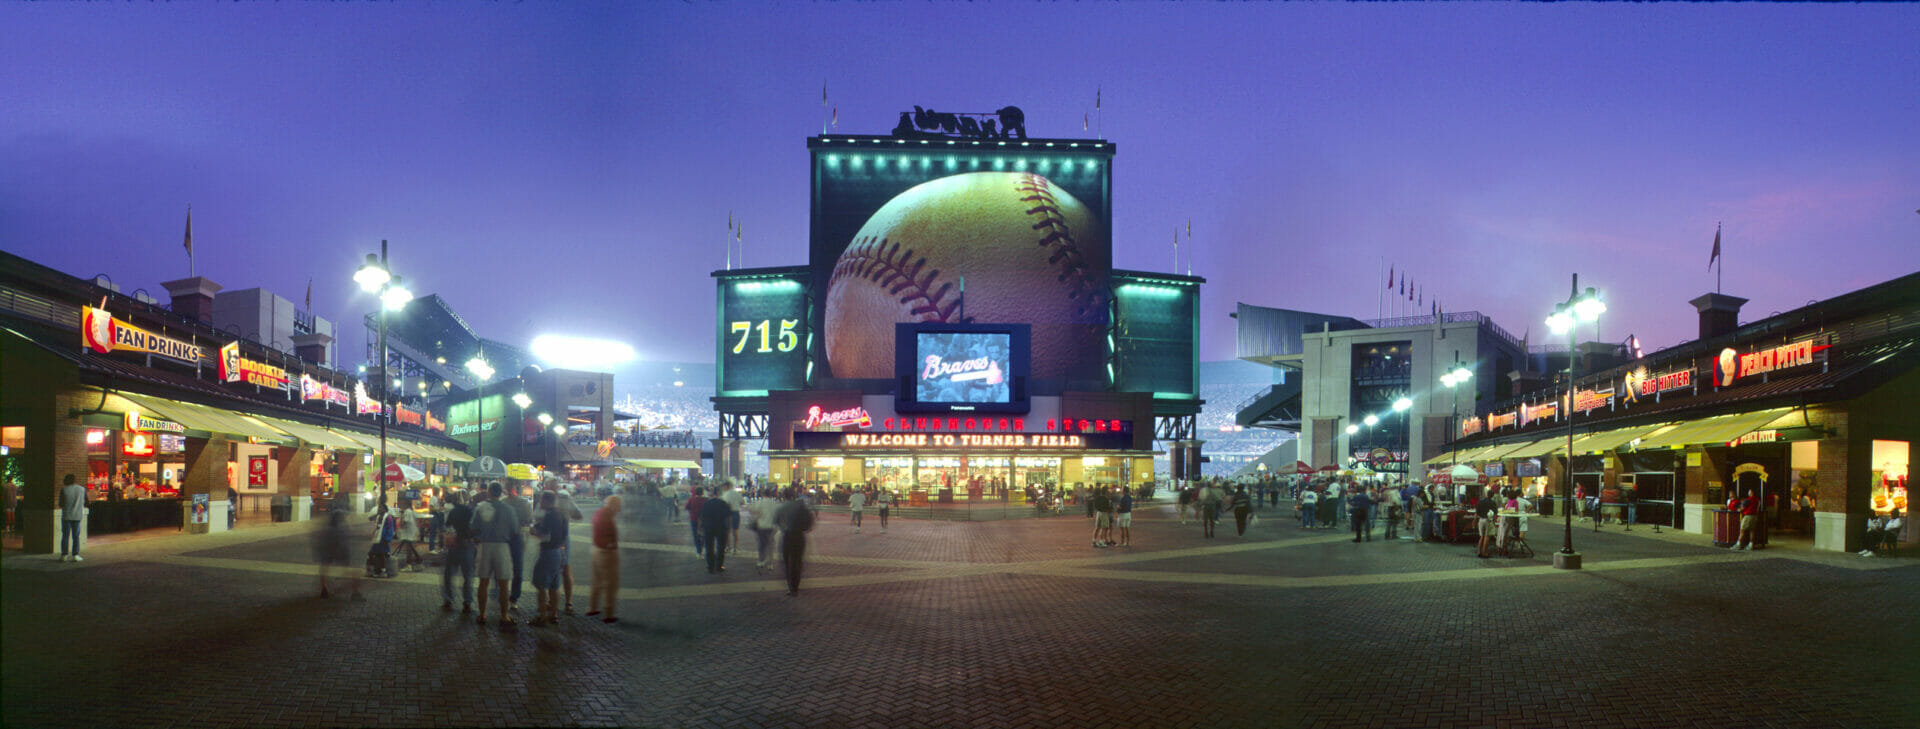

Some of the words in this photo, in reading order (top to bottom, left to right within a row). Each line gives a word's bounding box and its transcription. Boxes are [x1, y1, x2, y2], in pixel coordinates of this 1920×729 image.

[116, 325, 147, 350] FAN
[148, 333, 200, 362] DRINKS
[731, 318, 799, 354] 715
[240, 357, 285, 380] ROOKIE
[922, 354, 989, 381] Braves
[1740, 349, 1775, 377] PEACH
[1776, 339, 1813, 370] PITCH
[247, 372, 279, 390] CARD
[1641, 378, 1657, 396] BIG
[1657, 370, 1690, 391] HITTER
[139, 418, 155, 429] FAN
[155, 421, 184, 433] DRINKS
[450, 421, 496, 436] Budweser
[806, 405, 862, 429] Braves
[884, 417, 1025, 431] CLUBHOUSE
[1047, 418, 1121, 432] STORE
[845, 434, 928, 447] WELCOME
[933, 434, 955, 447] TO
[960, 435, 1026, 447] TURNER
[1031, 435, 1081, 447] FIELD
